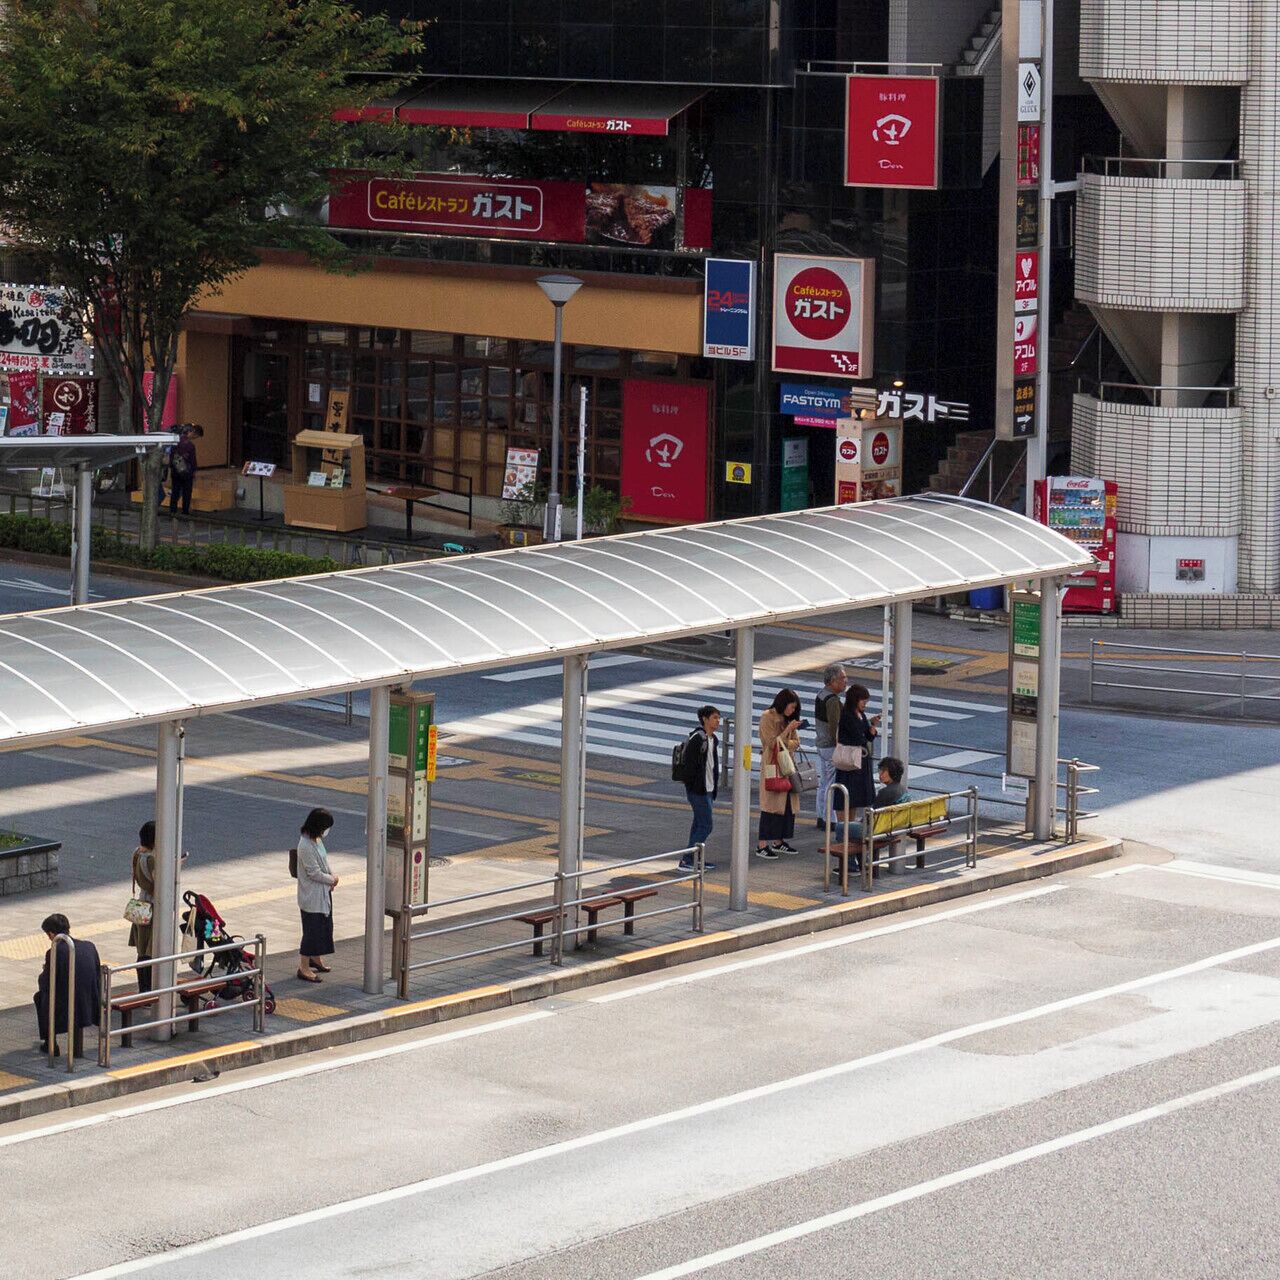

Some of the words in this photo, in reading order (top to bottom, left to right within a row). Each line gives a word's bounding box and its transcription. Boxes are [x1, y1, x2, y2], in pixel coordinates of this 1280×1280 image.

[567, 118, 605, 130] Caféレストラン
[606, 119, 632, 131] ガスト
[878, 160, 904, 169] Don
[376, 189, 468, 213] Caféレストラン
[472, 194, 534, 221] ガスト
[1016, 276, 1037, 291] アイフル
[793, 285, 843, 298] Caféレストラン
[708, 290, 733, 307] 24
[794, 299, 844, 320] ガスト
[708, 345, 747, 357] 当ビル5F
[1015, 346, 1036, 359] アコム
[848, 364, 858, 372] 2F
[783, 394, 840, 409] FASTGYM
[877, 390, 951, 422] ガスト
[873, 448, 889, 457] ガスト
[651, 486, 676, 499] Don
